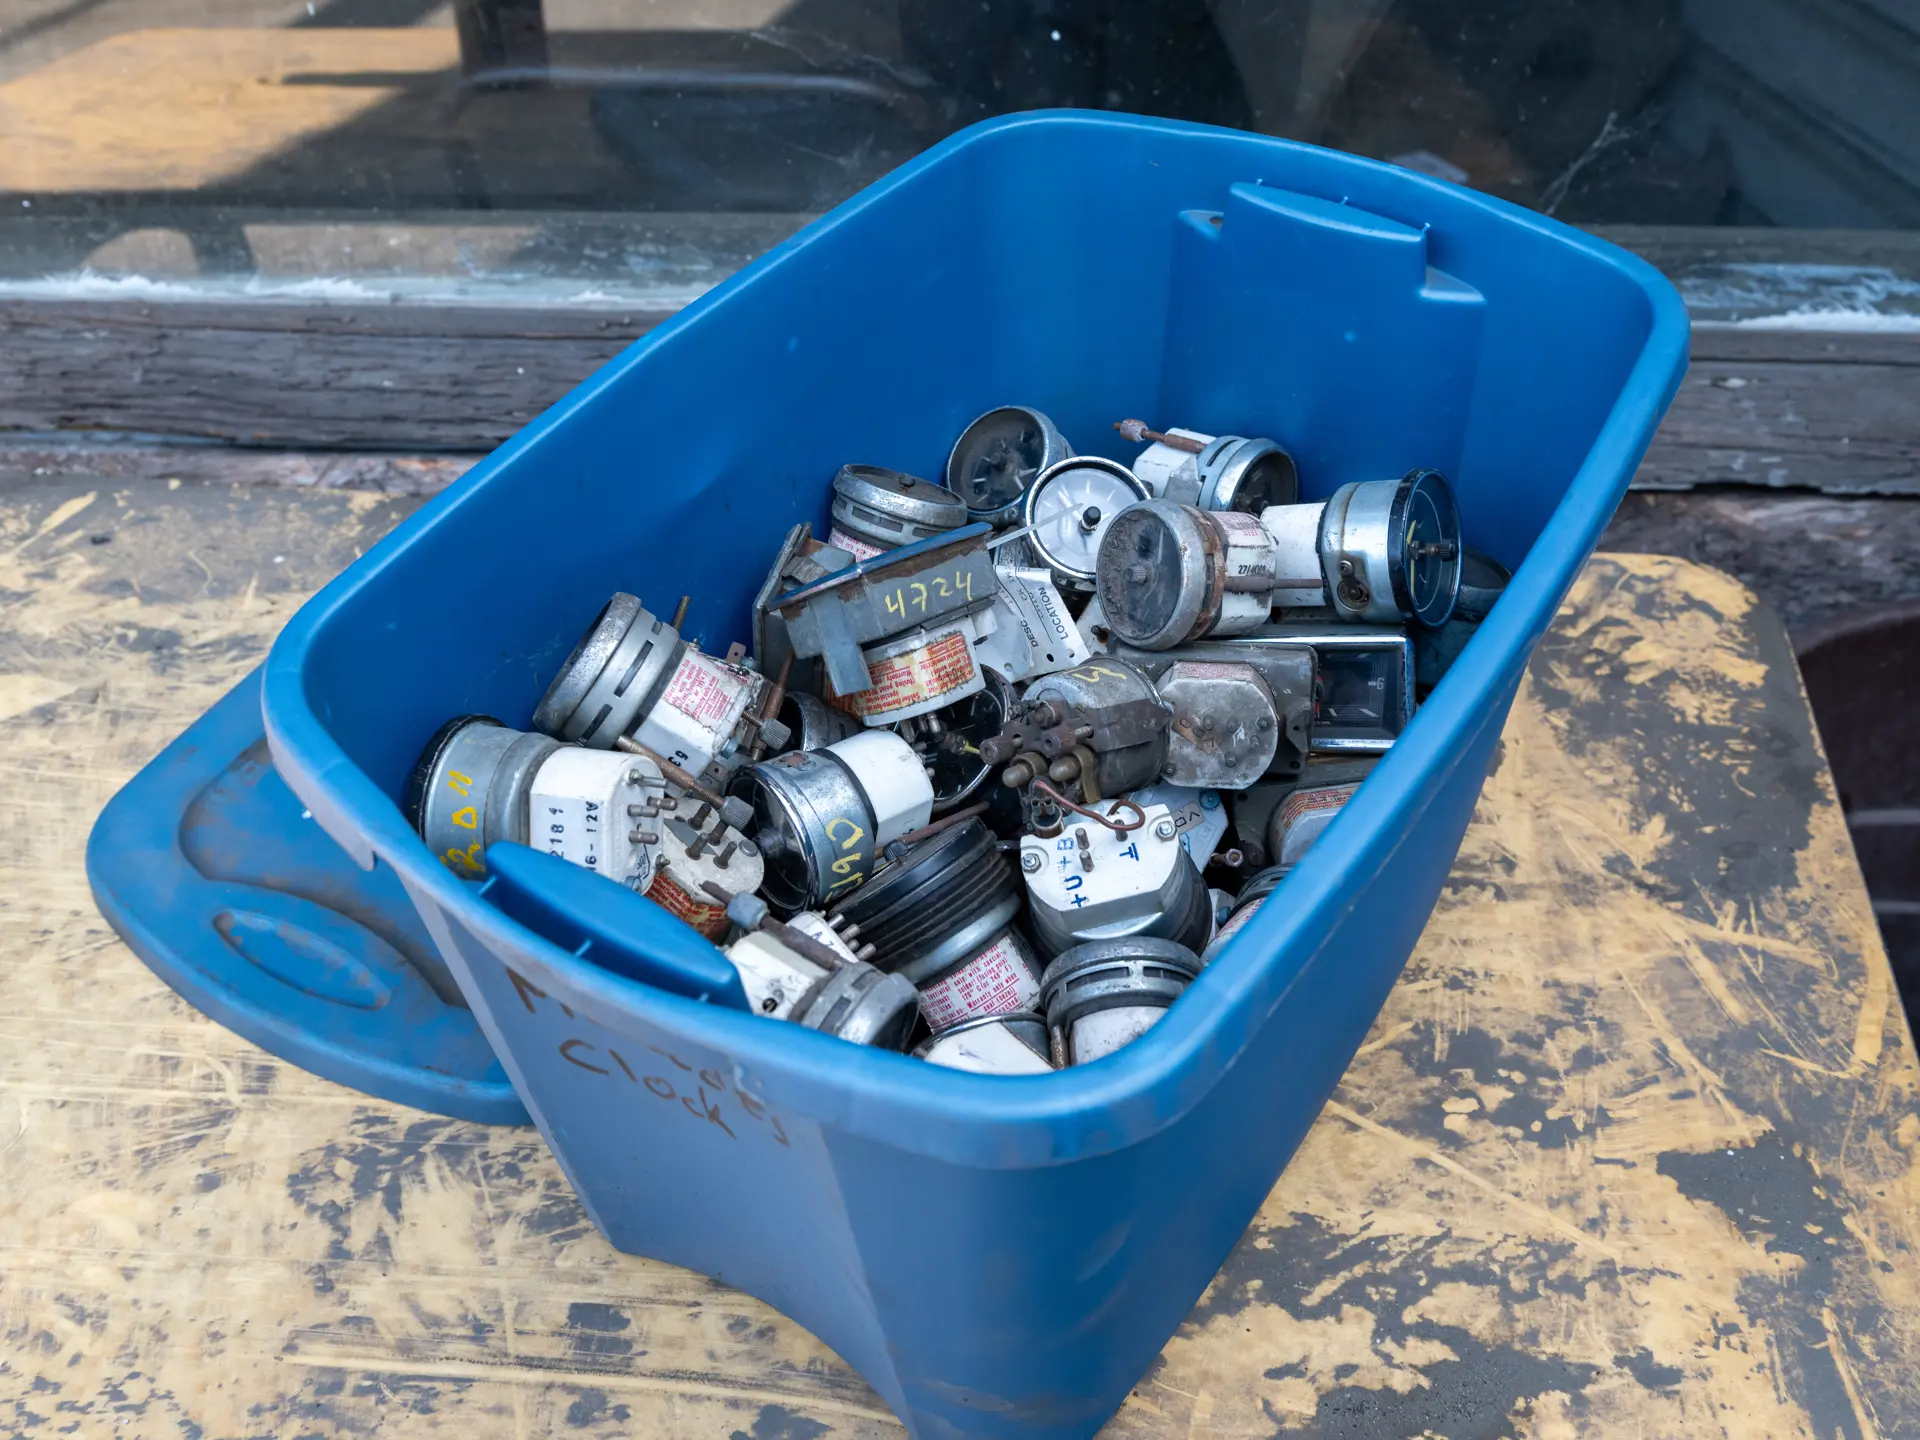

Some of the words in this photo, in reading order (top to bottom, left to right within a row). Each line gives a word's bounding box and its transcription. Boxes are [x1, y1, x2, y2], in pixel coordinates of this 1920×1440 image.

[885, 571, 973, 618] 4724
[1038, 588, 1068, 640] LOCATION
[1021, 621, 1038, 647] DESC
[1376, 677, 1384, 690] 6
[968, 966, 981, 977] with
[967, 990, 992, 1008] Warranty
[992, 981, 1004, 993] only
[1005, 972, 1017, 984] when
[997, 987, 1016, 1003] (bezel)
[558, 1037, 738, 1140] Clock
